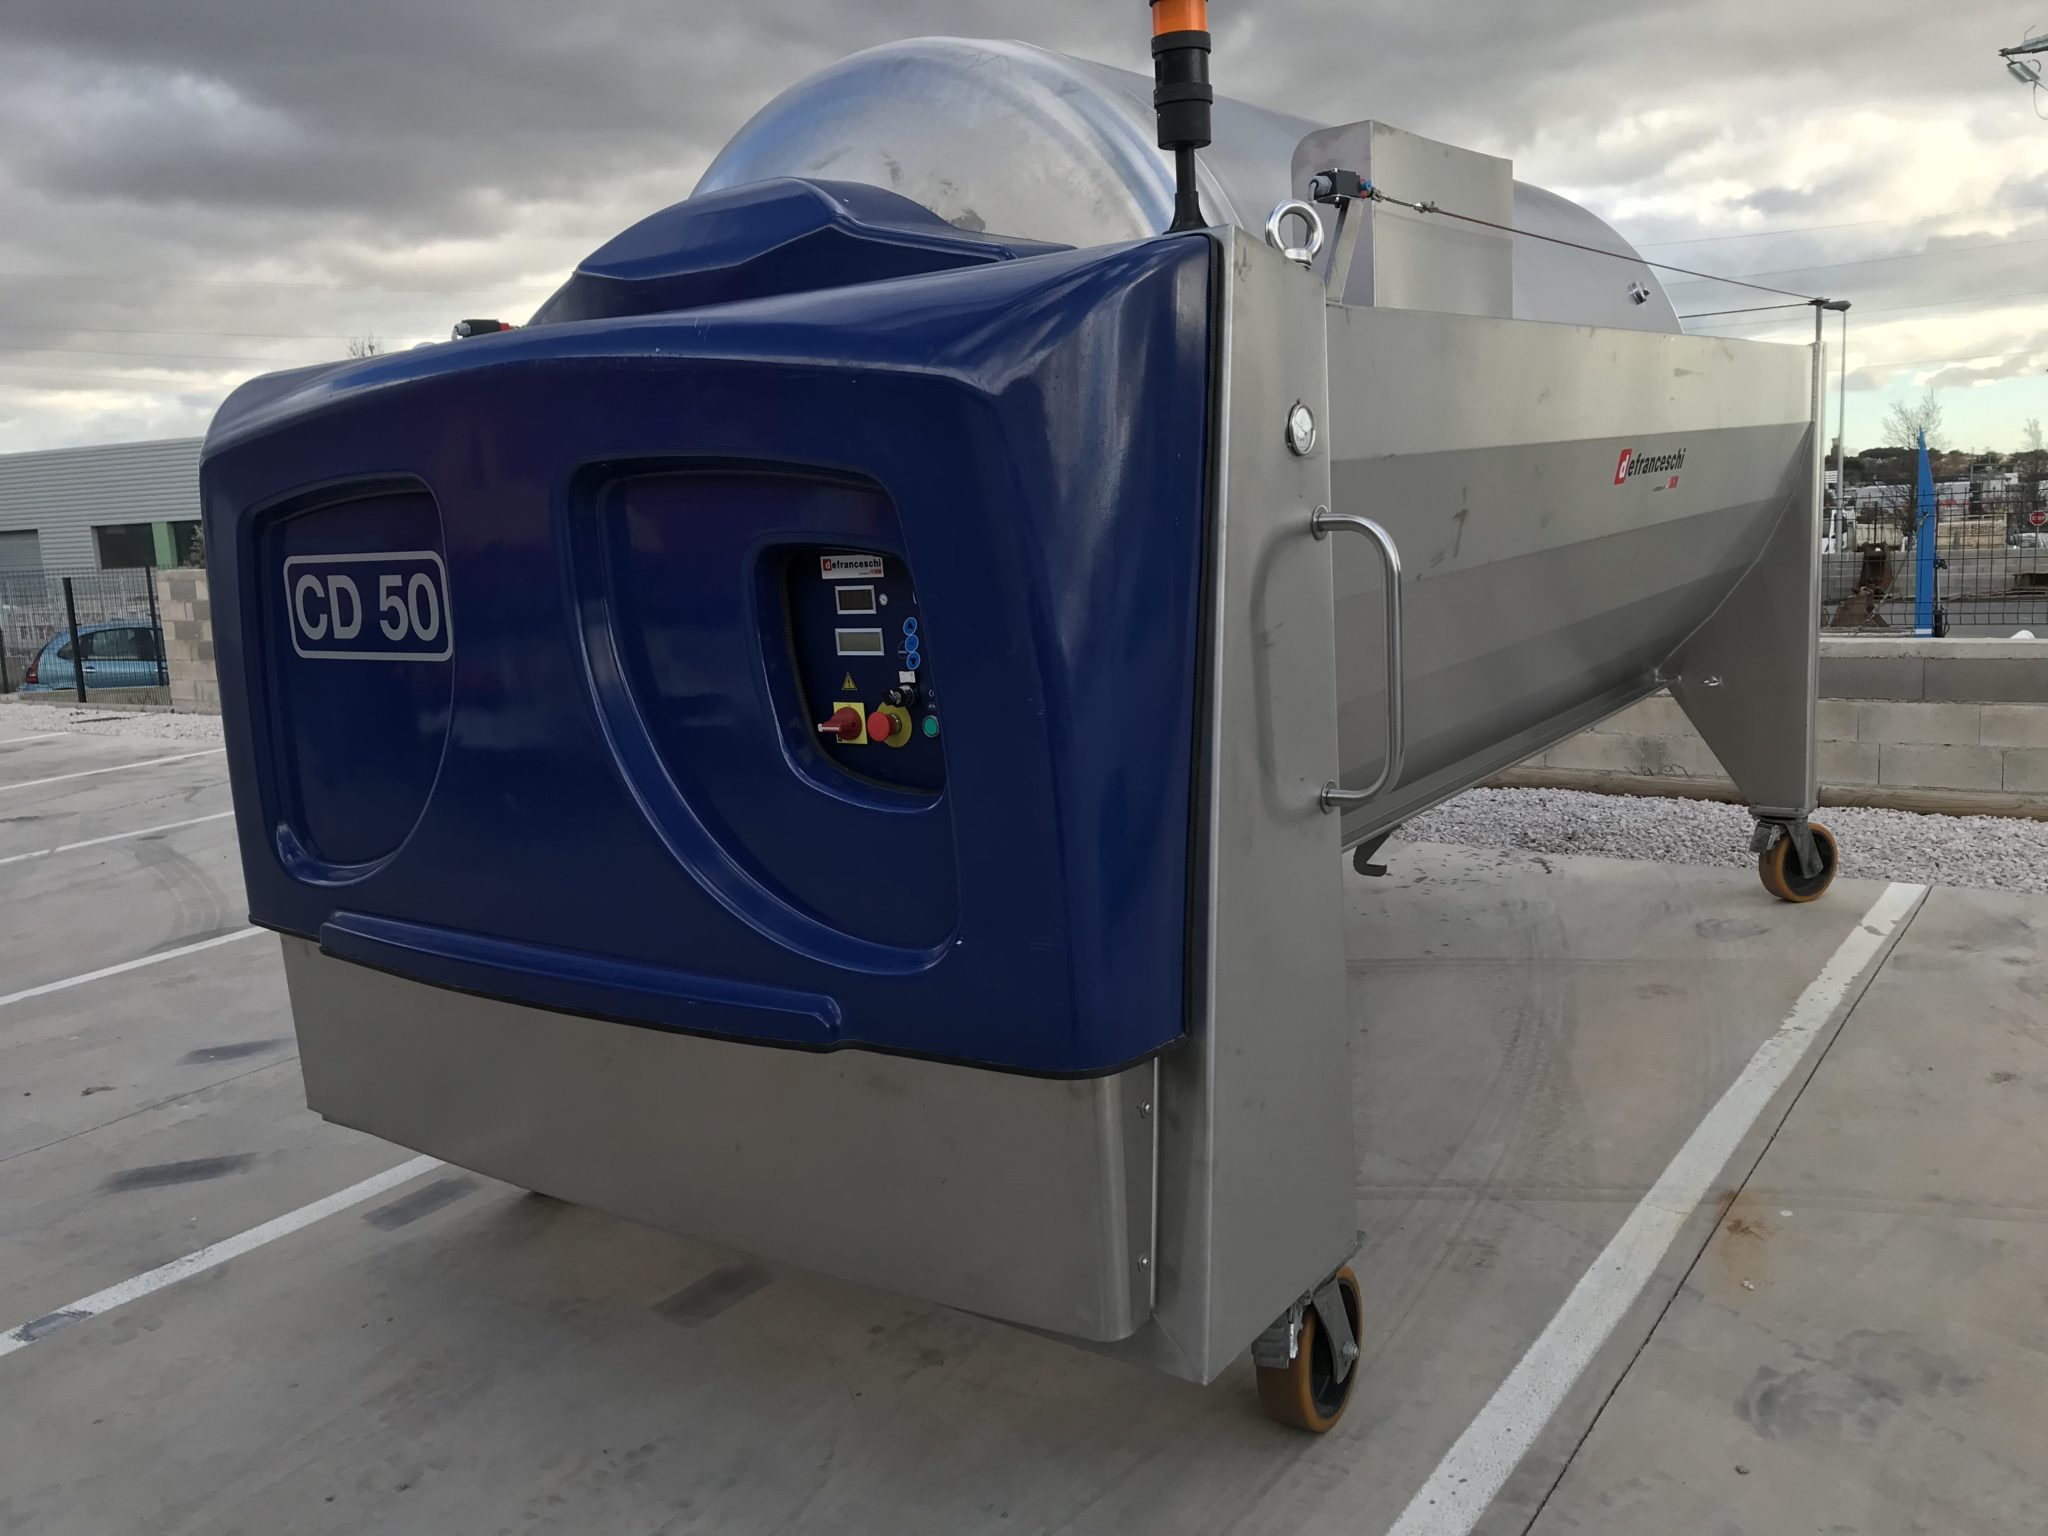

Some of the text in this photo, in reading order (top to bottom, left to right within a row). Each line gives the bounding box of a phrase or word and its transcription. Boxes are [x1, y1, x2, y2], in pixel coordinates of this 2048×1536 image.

[1617, 447, 1687, 482] defranceschi
[823, 558, 882, 570] defranceschi
[295, 573, 440, 641] CD 50
